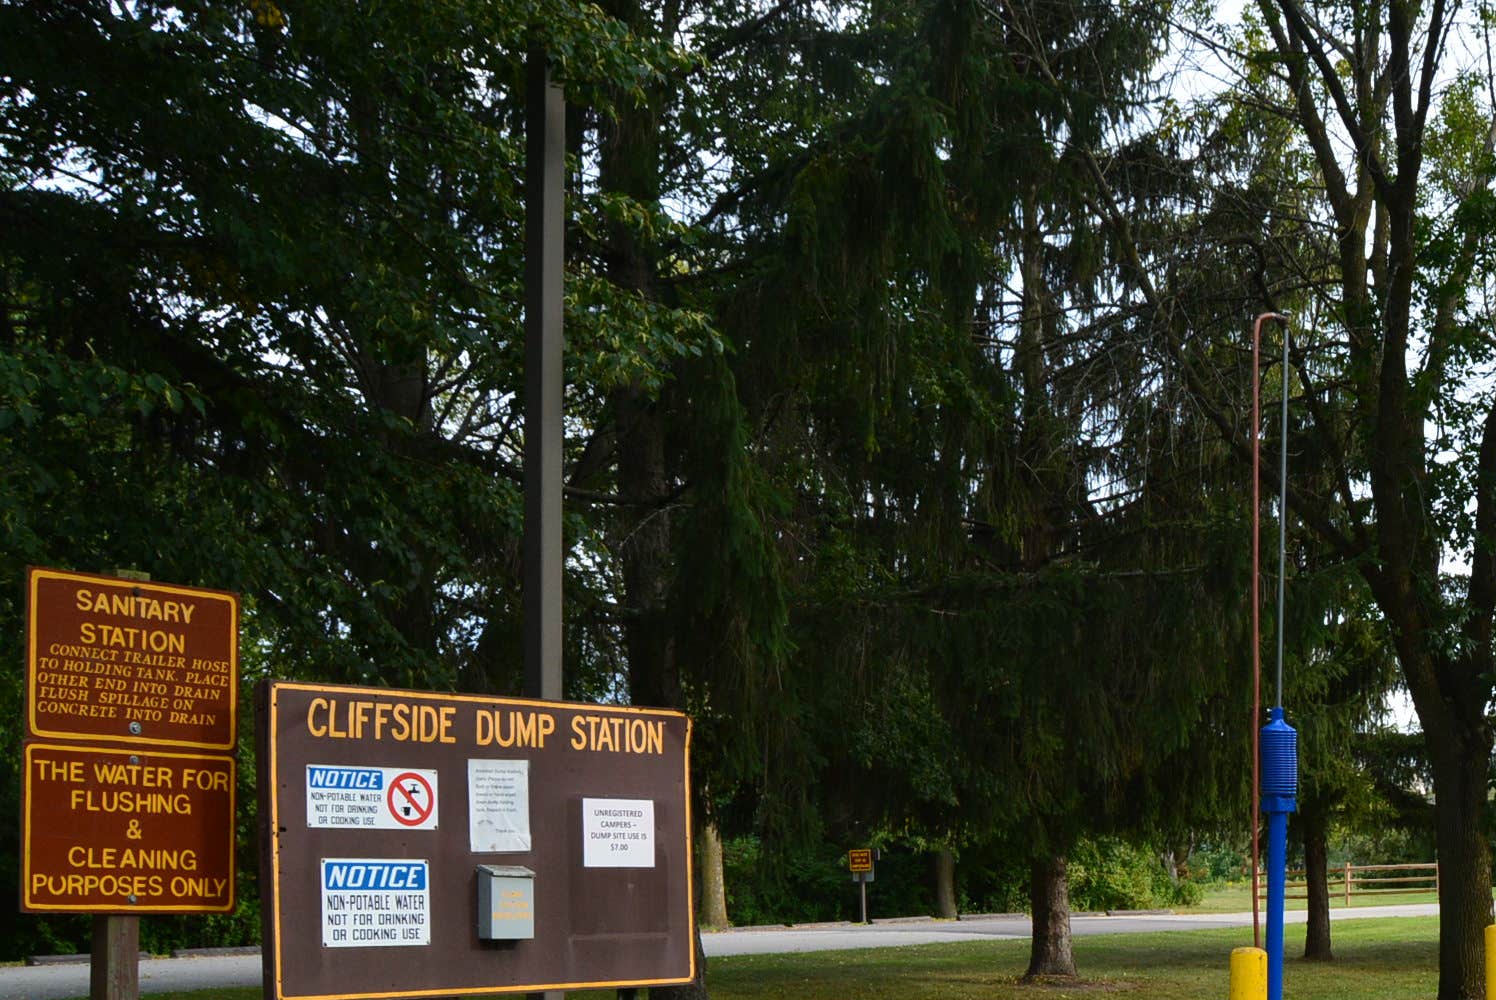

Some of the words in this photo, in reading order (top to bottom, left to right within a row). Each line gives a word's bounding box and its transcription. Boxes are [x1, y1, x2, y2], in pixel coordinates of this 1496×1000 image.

[77, 589, 195, 624] SANITARY
[80, 623, 184, 654] STATION
[50, 644, 118, 661] CONNECT
[124, 652, 185, 668] TRAILER
[192, 659, 229, 673] HOSE
[39, 658, 58, 669] TO
[63, 659, 132, 677] HOLDING
[185, 673, 228, 687] PLACE
[38, 672, 88, 687] OTHER
[95, 678, 126, 691] END
[133, 682, 167, 694] INTO
[175, 686, 220, 699] DRAIN
[40, 687, 88, 701] FLUSH
[99, 693, 168, 709] SPILLAGE
[174, 700, 193, 711] ON
[37, 701, 117, 718] CONCRETE
[126, 708, 162, 722] INTO
[169, 712, 216, 725] DRAIN
[307, 698, 456, 743] CLIFFSIDE
[476, 711, 554, 748] DUMP
[571, 715, 663, 754] STATION
[34, 760, 84, 782] THE
[94, 764, 172, 788] WATER
[182, 769, 228, 792] FOR
[312, 770, 380, 788] NOTICE
[72, 790, 191, 815] FLUSHING
[311, 792, 356, 802] NON-POTABLE
[361, 793, 381, 802] WATER
[315, 804, 328, 813] NOT
[331, 805, 344, 813] FOR
[347, 805, 377, 813] DRINKING
[127, 819, 141, 839] &
[318, 816, 328, 824] OR
[331, 816, 360, 825] COOKING
[363, 817, 375, 825] USE
[68, 847, 196, 870] CLEANING
[32, 874, 163, 896] PURPOSES
[171, 877, 226, 897] ONLY
[328, 866, 422, 887] NOTICE
[327, 895, 390, 910] NON-POTABLE
[396, 895, 424, 910] WATER
[328, 914, 347, 925] NOT
[354, 914, 372, 925] FOR
[379, 913, 424, 925] DRINKING
[333, 929, 347, 940] OR
[353, 928, 397, 940] COOKING
[403, 928, 420, 939] USE
